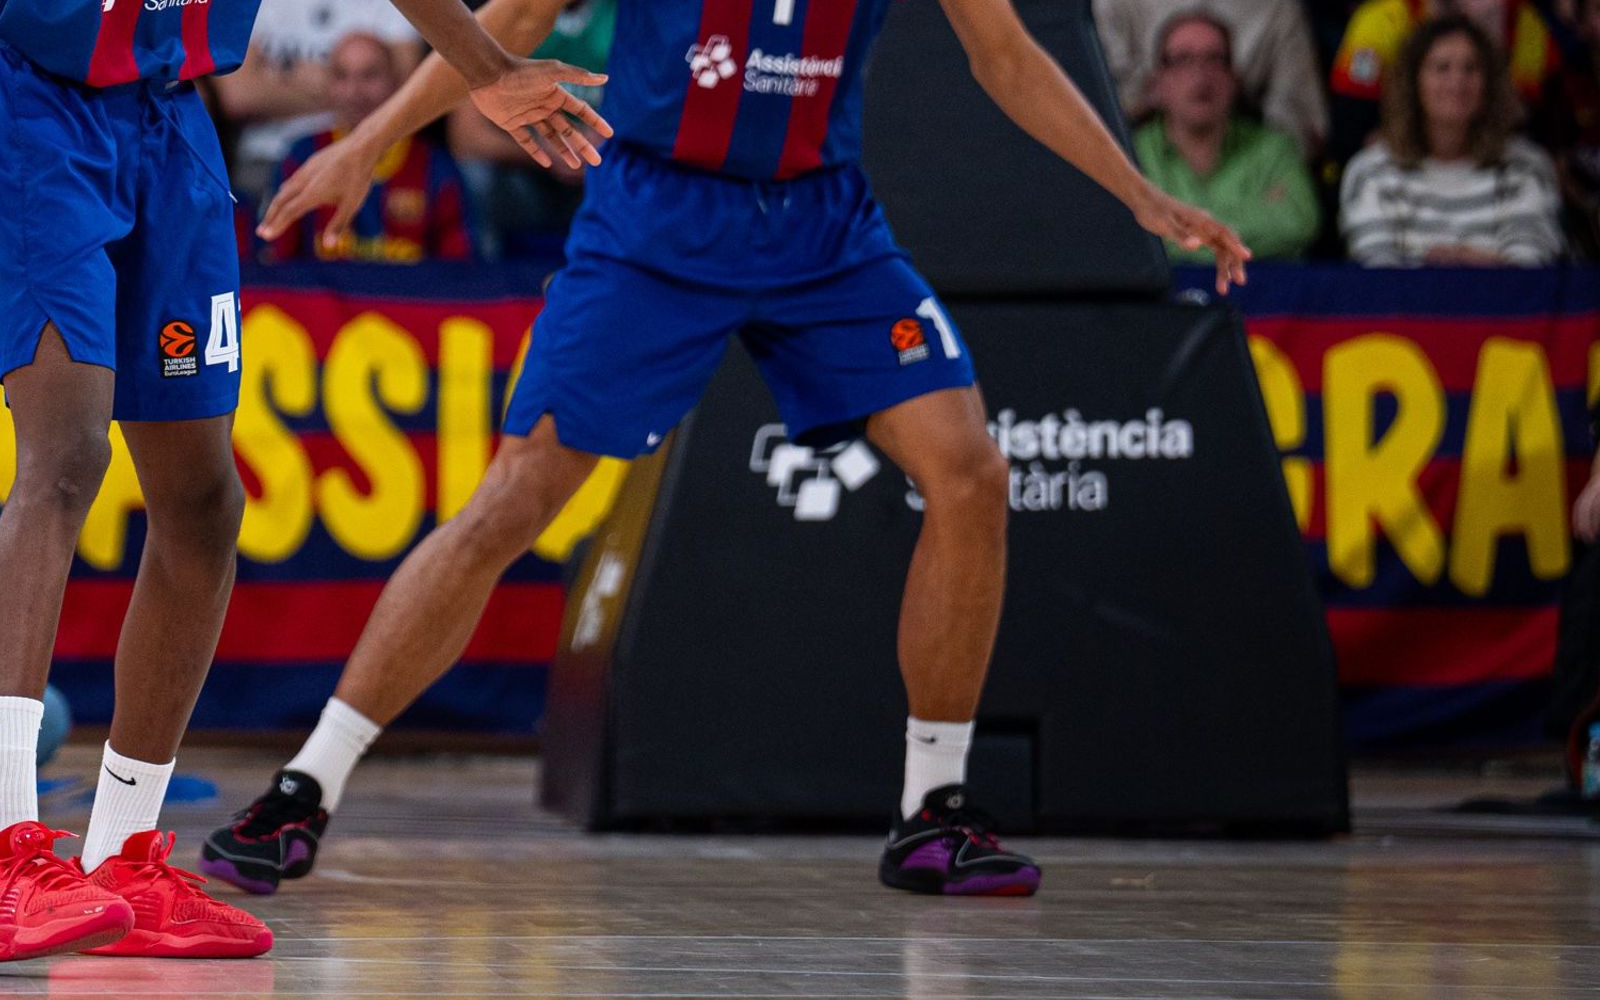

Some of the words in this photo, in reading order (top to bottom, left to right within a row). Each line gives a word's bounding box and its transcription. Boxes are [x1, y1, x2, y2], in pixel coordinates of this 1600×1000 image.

[204, 291, 242, 373] 4
[915, 295, 962, 360] 1
[163, 356, 196, 365] TURKISH
[164, 363, 197, 371] AIRLINES
